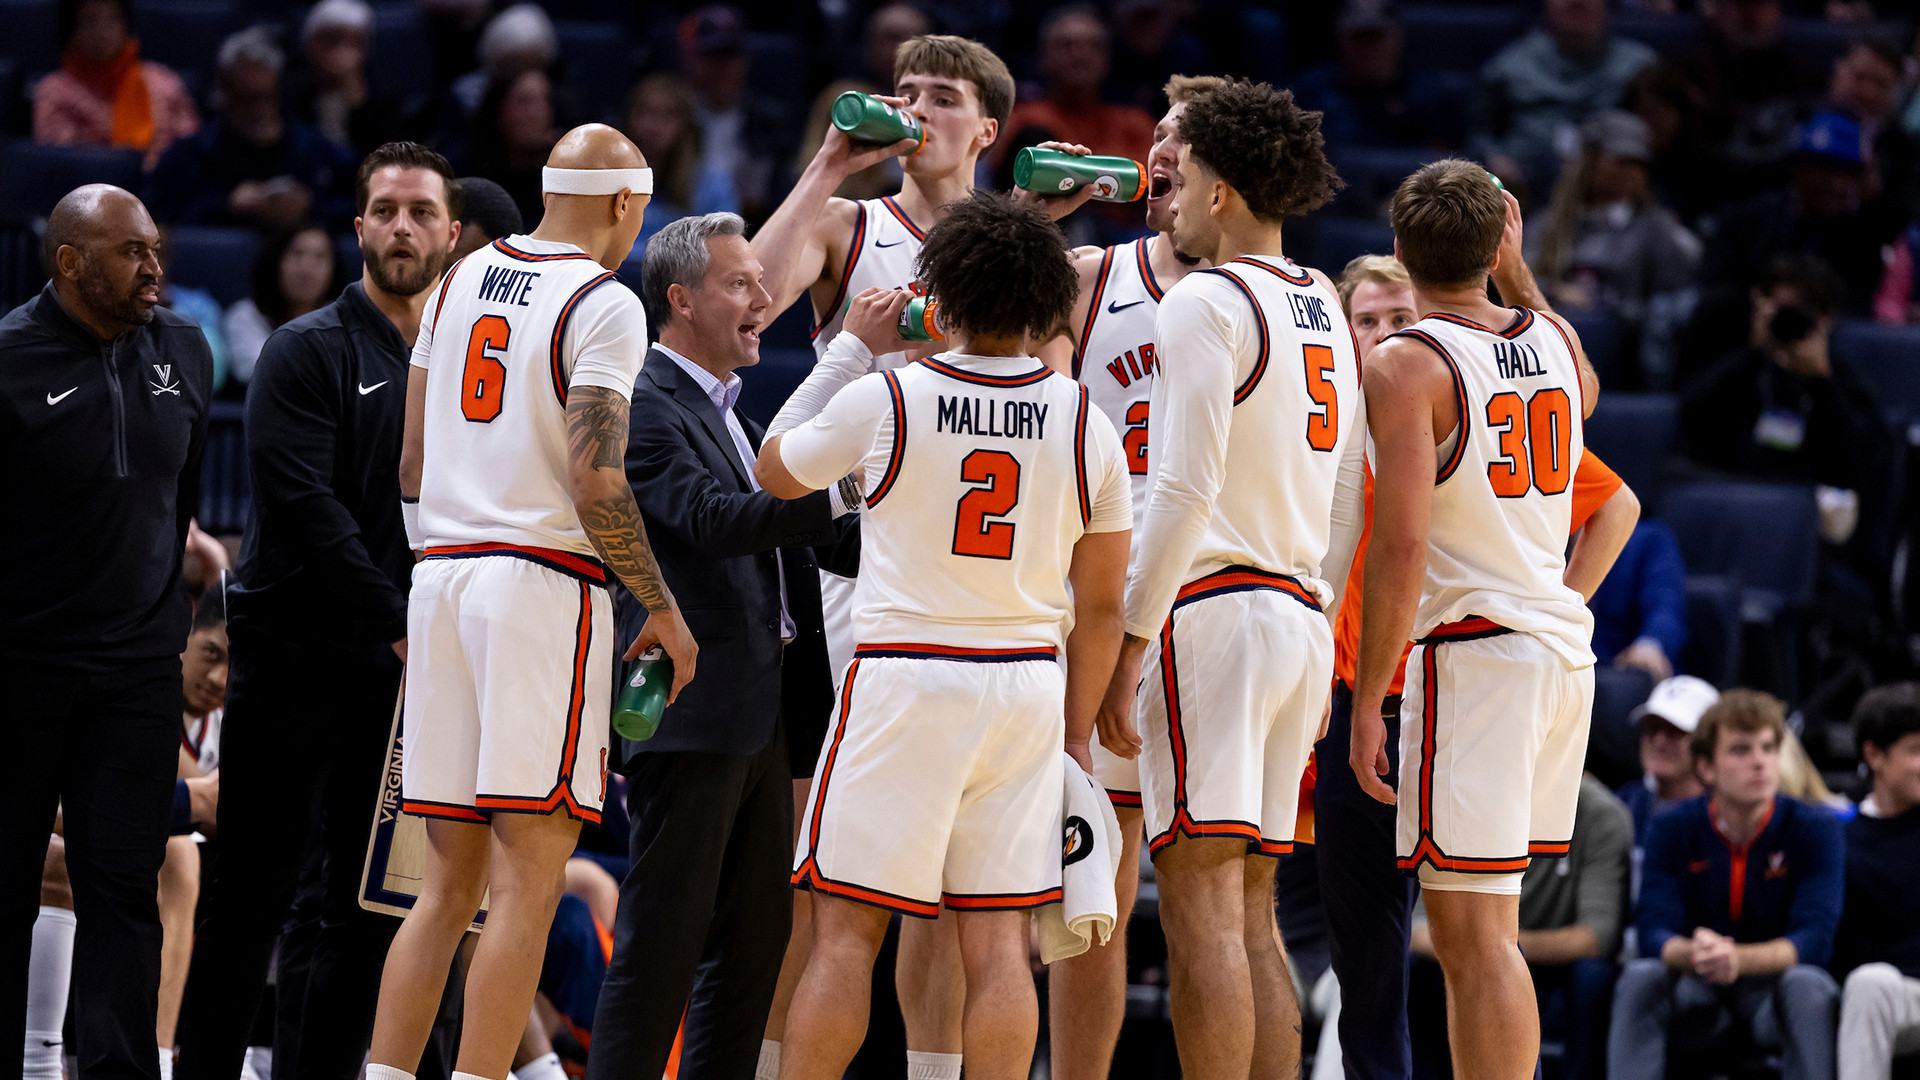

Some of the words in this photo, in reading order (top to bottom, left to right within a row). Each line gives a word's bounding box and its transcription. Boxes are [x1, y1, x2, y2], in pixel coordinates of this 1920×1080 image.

[478, 265, 541, 307] WHITE
[1286, 292, 1331, 332] LEWIS
[461, 314, 511, 423] 6
[1106, 343, 1160, 389] VIR
[1493, 342, 1547, 379] HALL
[937, 395, 1048, 440] MALLORY
[1302, 343, 1338, 452] 5
[1485, 387, 1571, 498] 30
[951, 448, 1021, 560] 2
[380, 736, 404, 824] VIRGINIA
